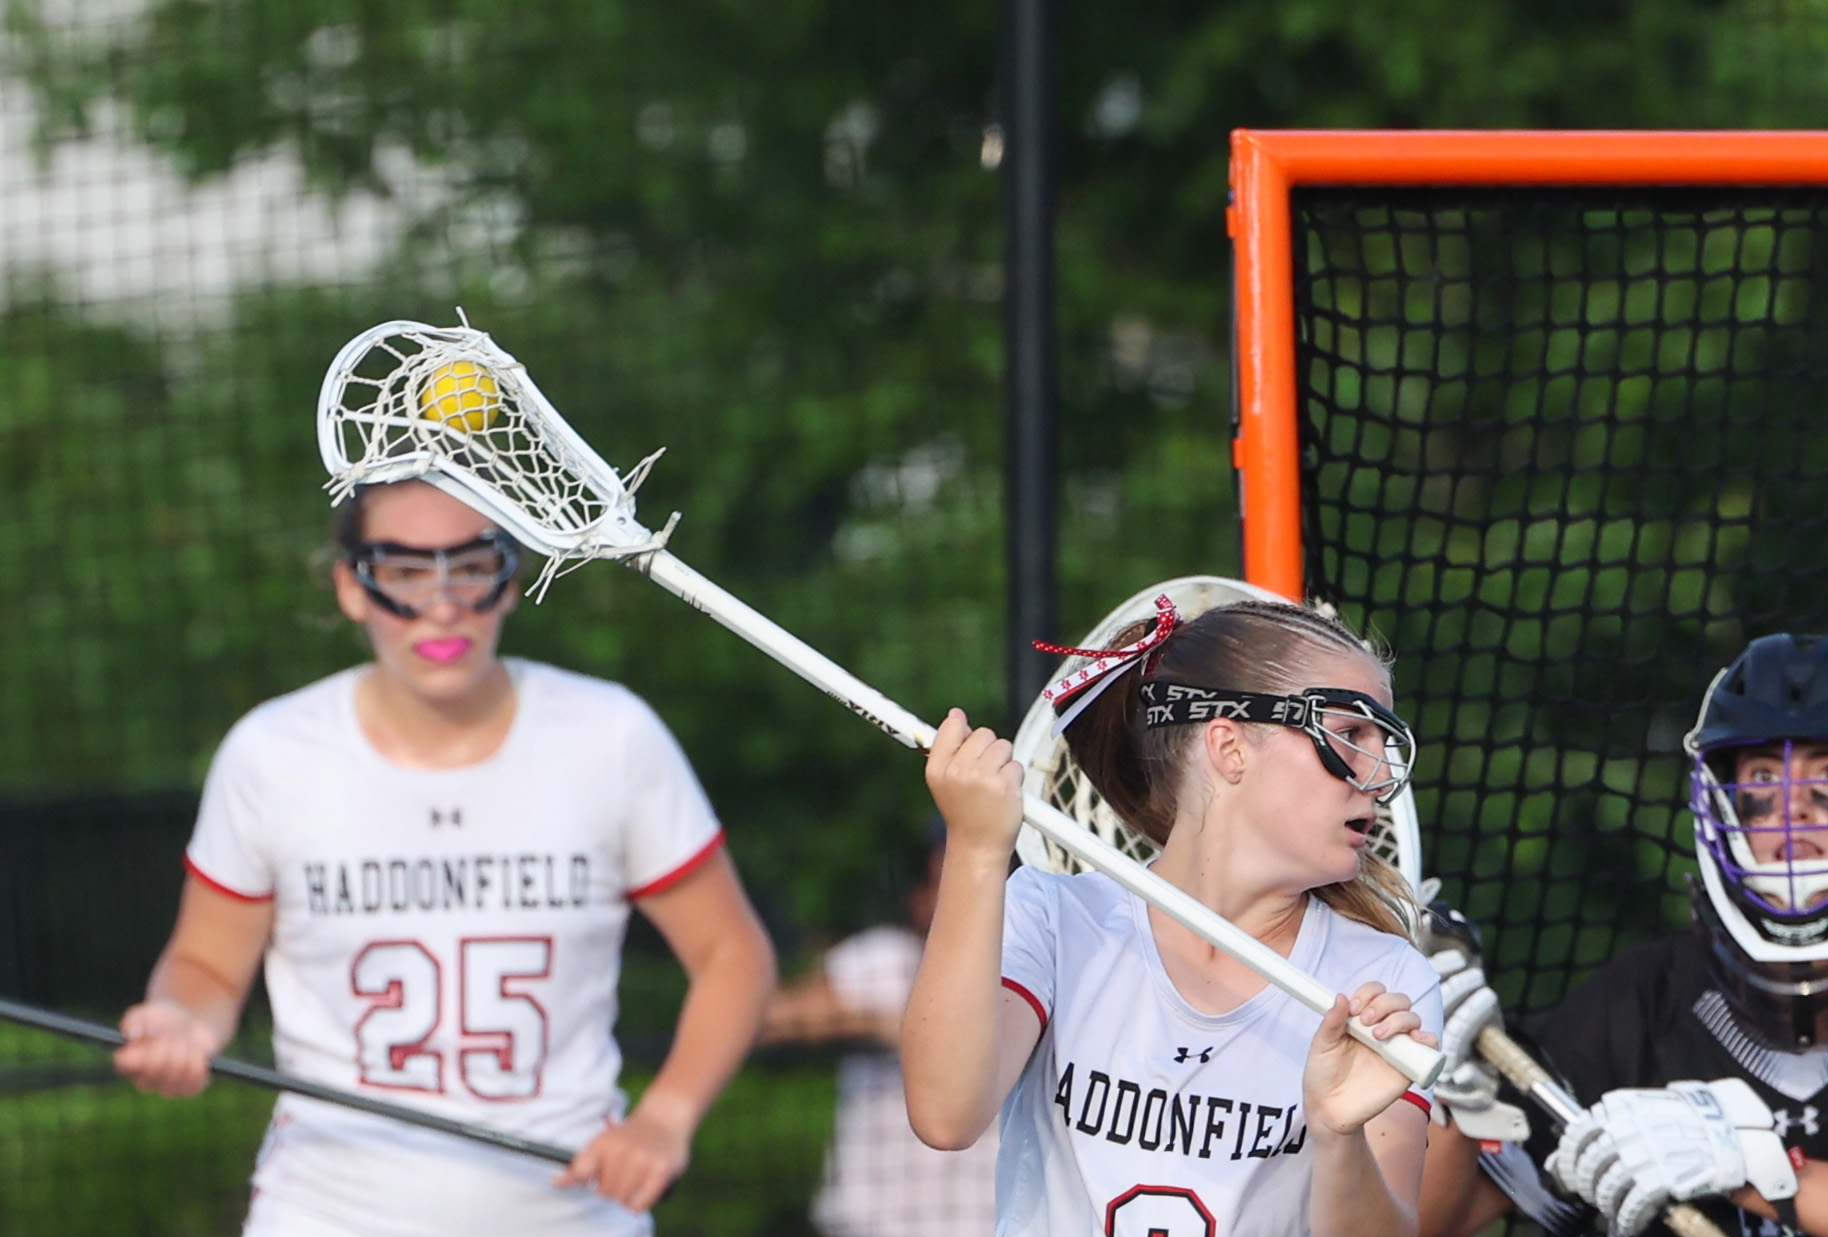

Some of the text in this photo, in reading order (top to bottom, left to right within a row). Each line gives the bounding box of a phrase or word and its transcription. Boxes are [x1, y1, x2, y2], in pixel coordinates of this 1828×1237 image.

[1188, 700, 1251, 720] STX
[303, 854, 591, 915] HADDONFIELD
[350, 935, 554, 1102] 25
[1053, 1061, 1308, 1161] ADDONFIEL
